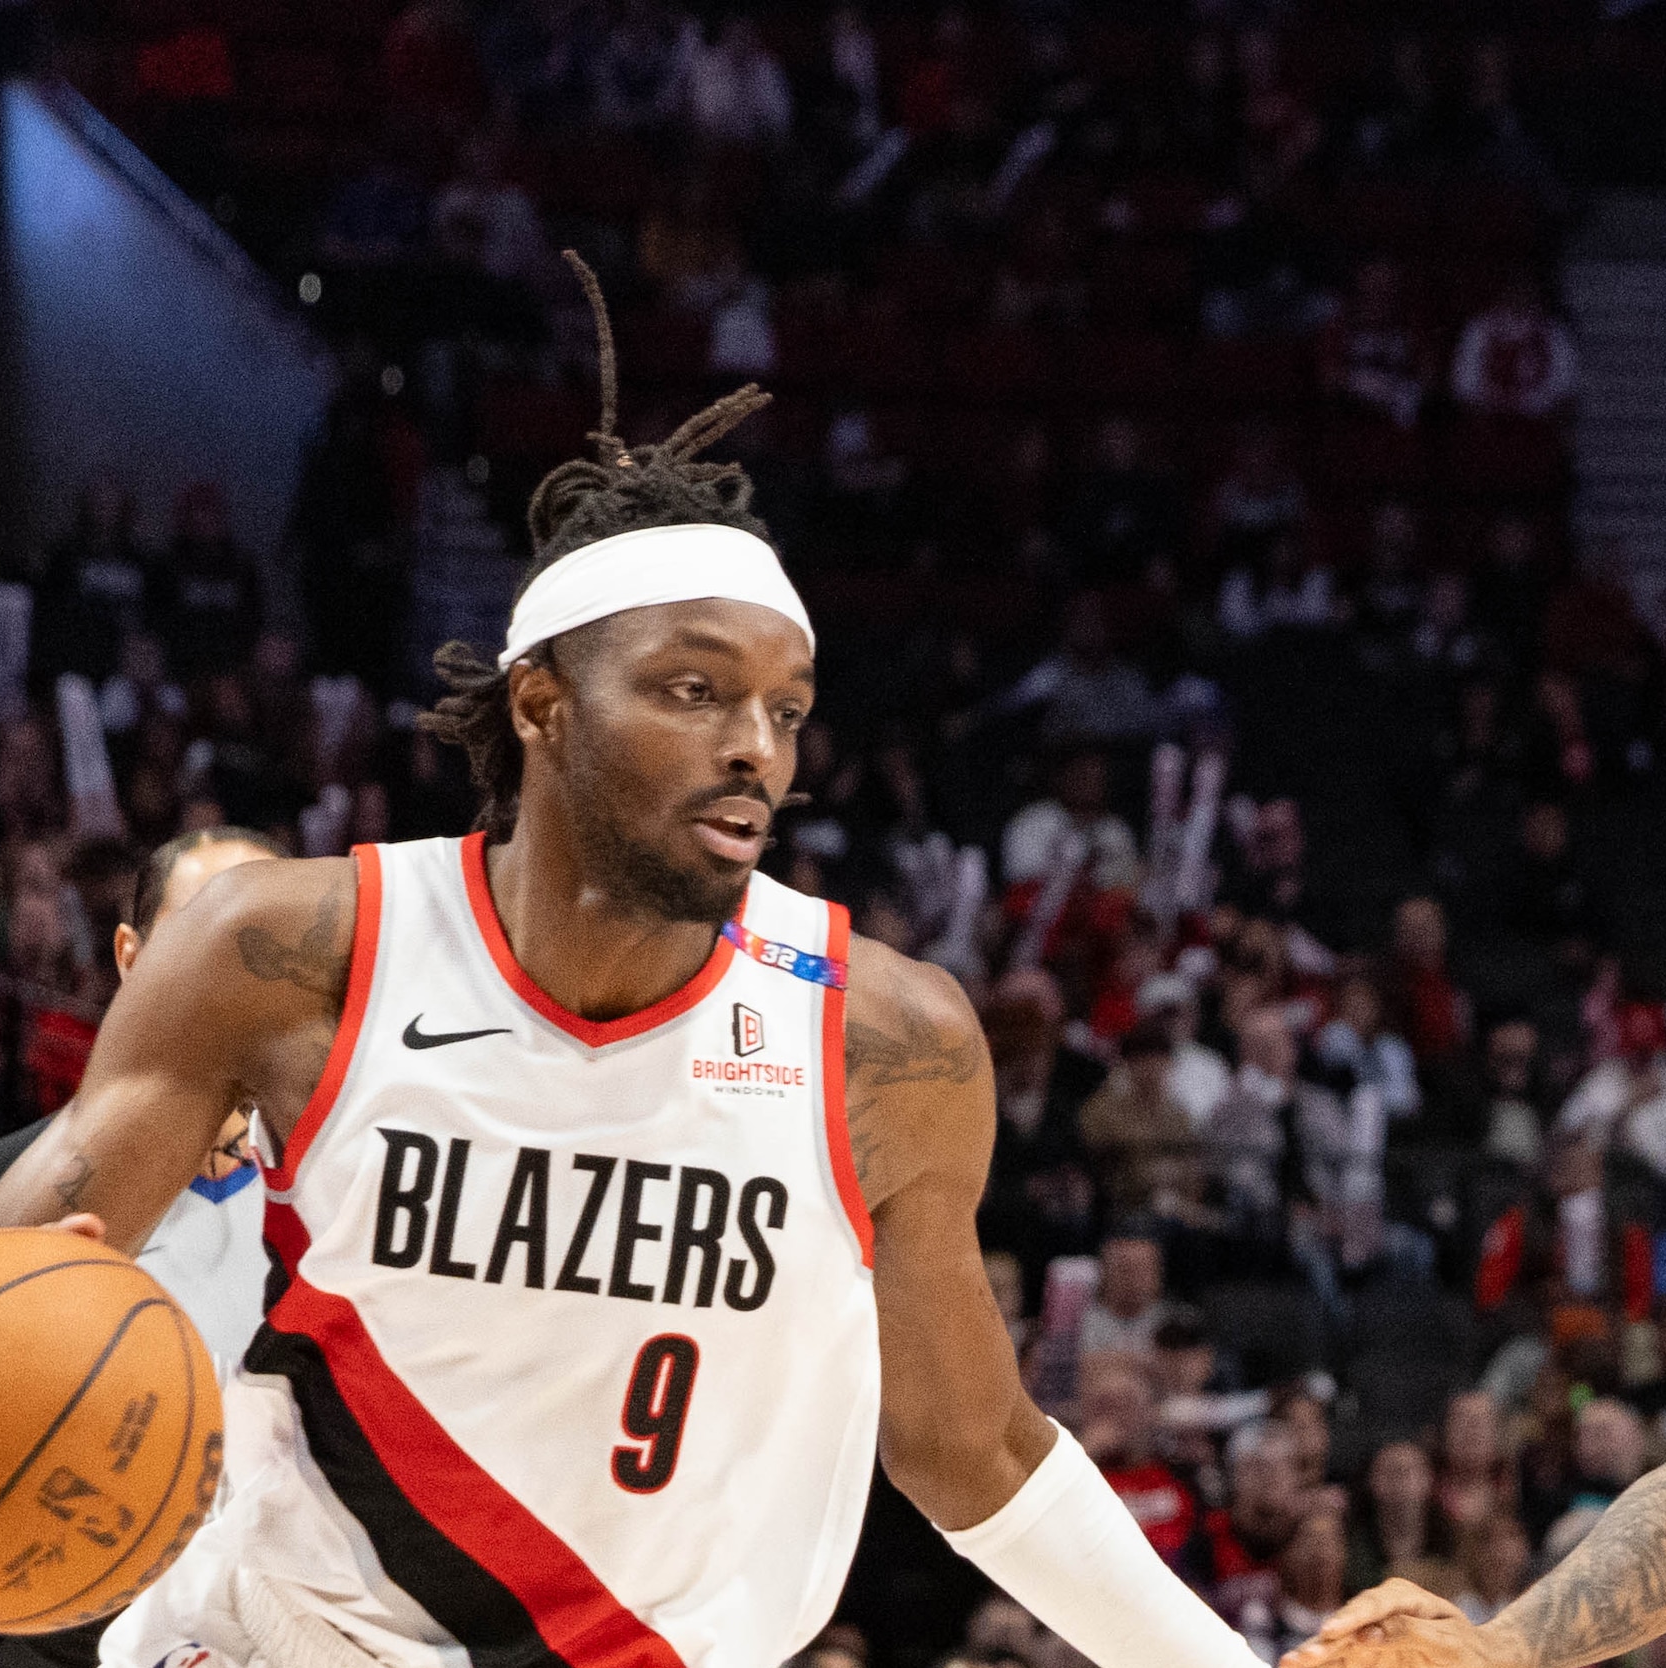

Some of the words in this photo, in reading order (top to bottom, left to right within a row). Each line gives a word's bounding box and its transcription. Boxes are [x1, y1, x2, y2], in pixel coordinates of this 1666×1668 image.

[760, 942, 798, 971] 32
[692, 1059, 805, 1086] BRIGHTSIDE
[714, 1086, 785, 1098] WINDOWS
[371, 1126, 789, 1312] BLAZERS
[610, 1332, 700, 1495] 9
